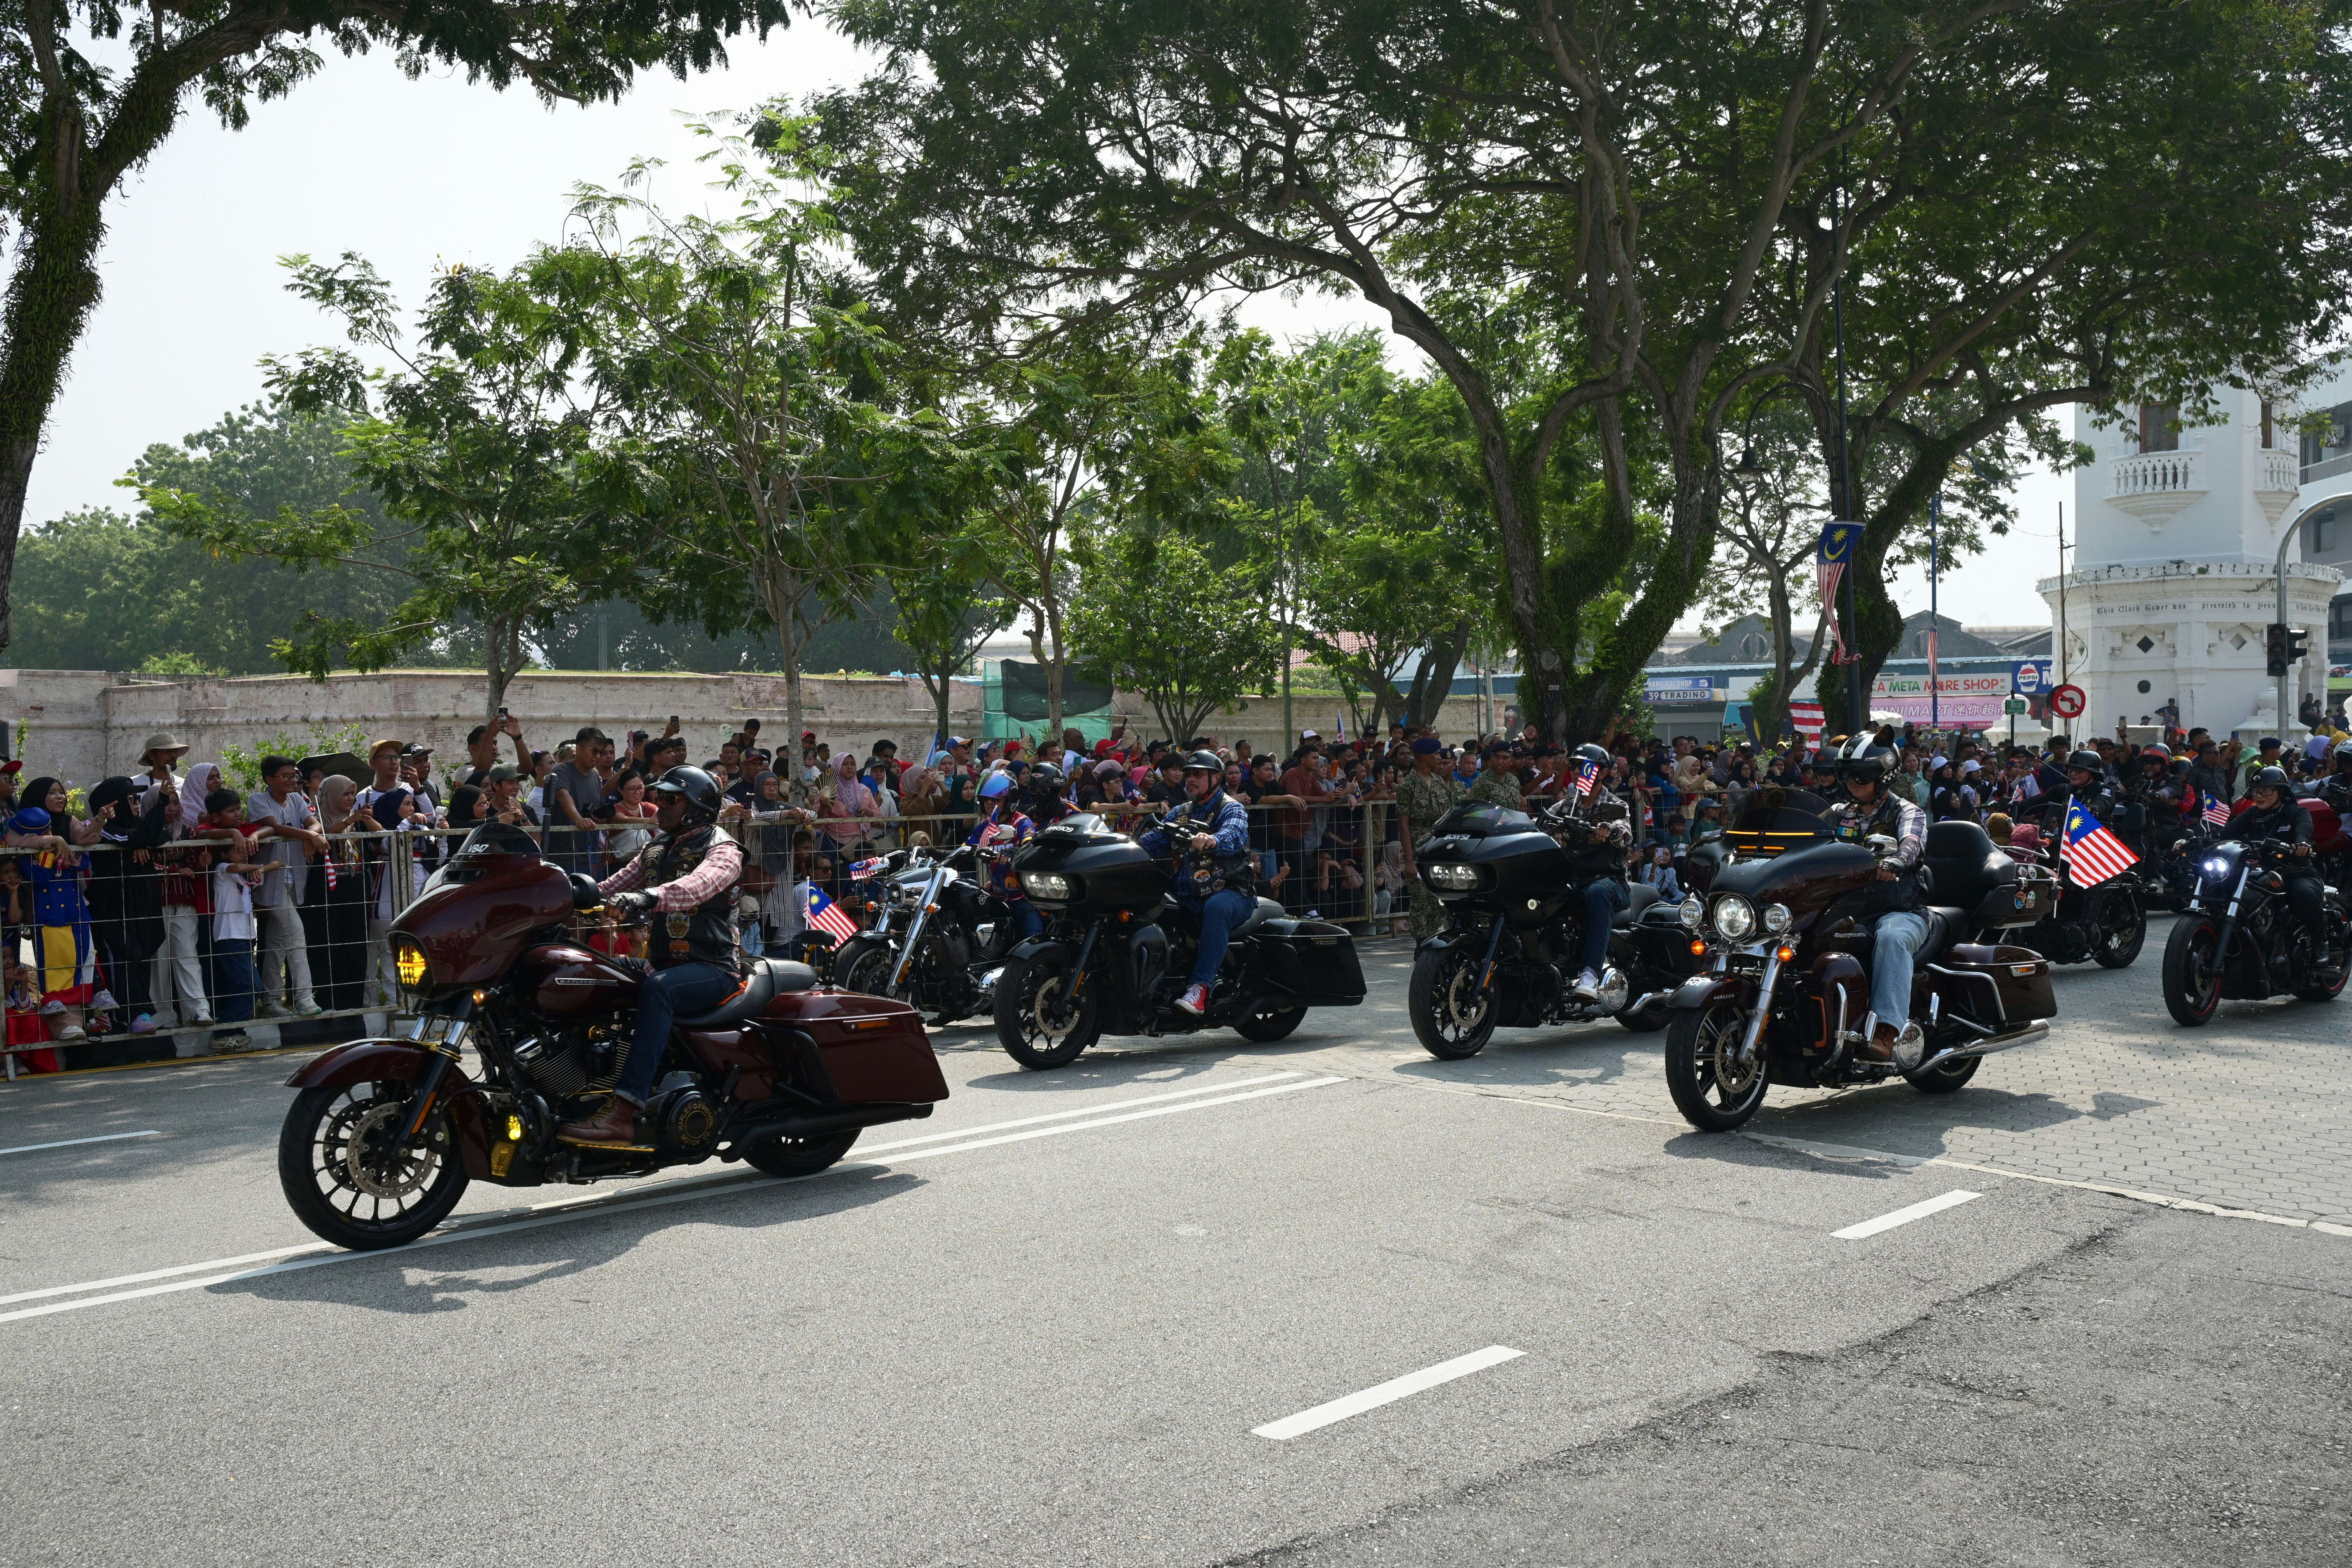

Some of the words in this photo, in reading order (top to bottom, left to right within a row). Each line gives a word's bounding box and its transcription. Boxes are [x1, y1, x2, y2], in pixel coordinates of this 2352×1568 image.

[2097, 607, 2114, 615] This
[1877, 681, 1885, 692] A
[1889, 681, 1920, 692] META
[1964, 679, 1999, 690] SHOP
[1648, 691, 1659, 700] 39
[1872, 705, 1905, 716] MINI
[468, 844, 490, 853] VB47
[1907, 1038, 1920, 1049] 114
[681, 1134, 700, 1146] MOTOR
